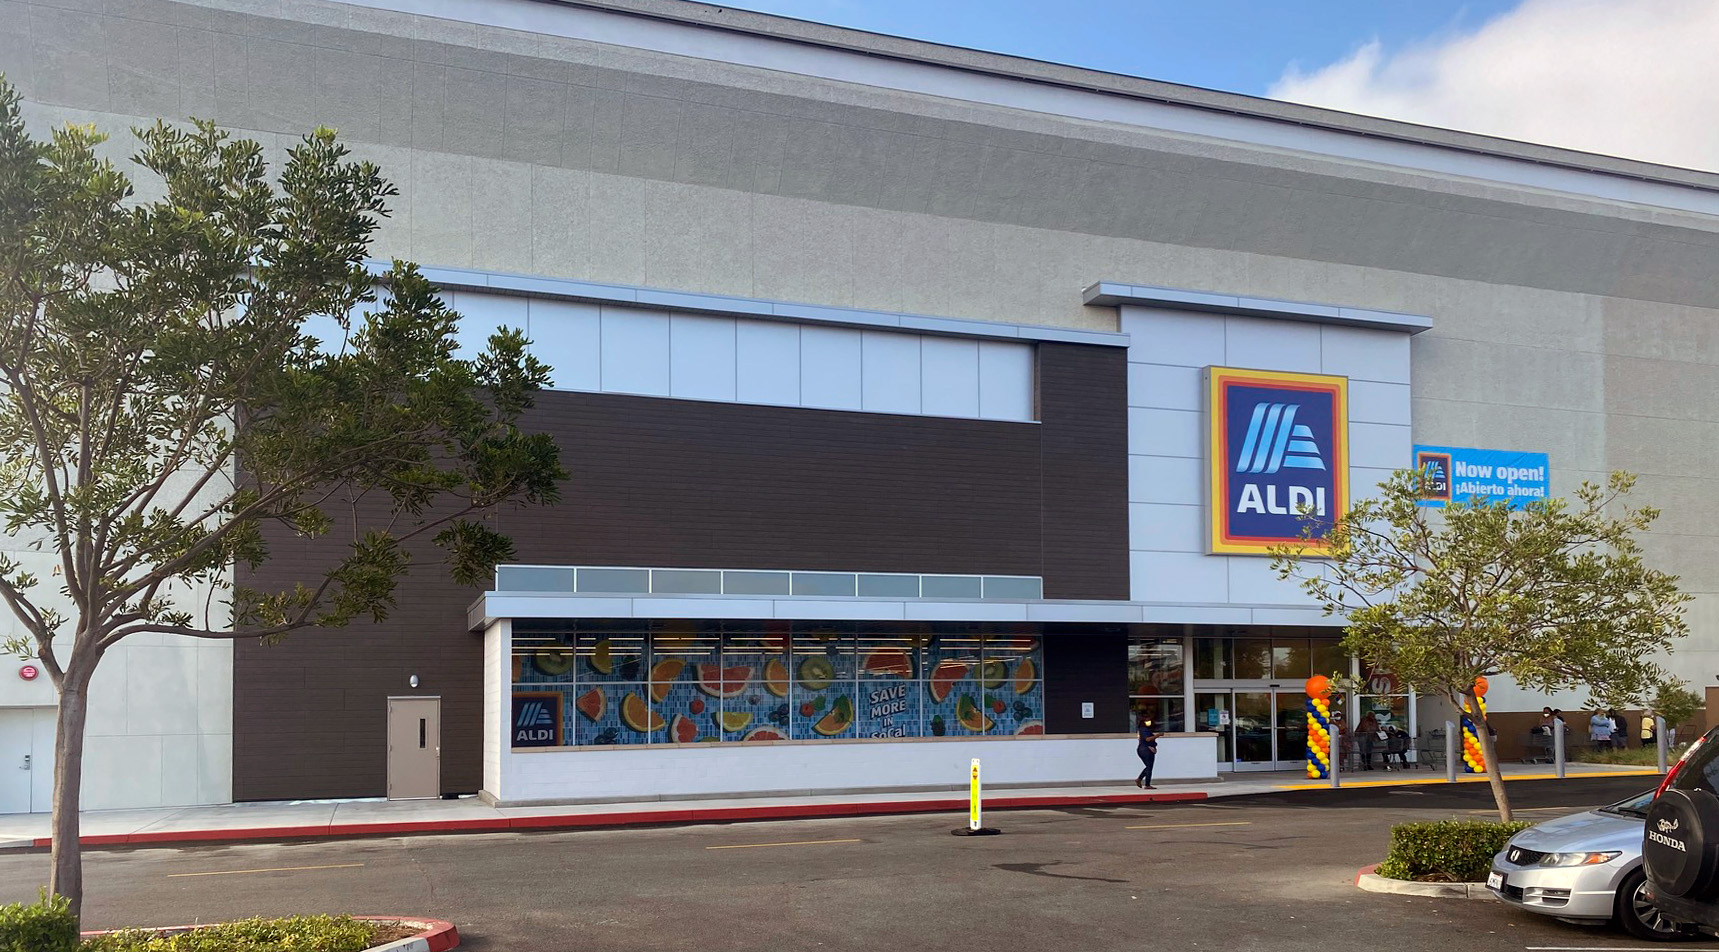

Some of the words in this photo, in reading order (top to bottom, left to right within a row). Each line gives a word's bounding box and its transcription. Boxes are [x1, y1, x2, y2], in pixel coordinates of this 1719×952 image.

[1455, 461, 1492, 479] Now
[1496, 466, 1544, 484] open!
[1456, 481, 1504, 495] ¡Abierto
[1507, 484, 1544, 497] ahora!
[1237, 483, 1325, 516] ALDI
[870, 684, 906, 704] SAVE
[871, 700, 906, 719] MORE
[883, 716, 893, 727] IN
[516, 729, 553, 741] ALDI
[1649, 830, 1686, 852] HONDA
